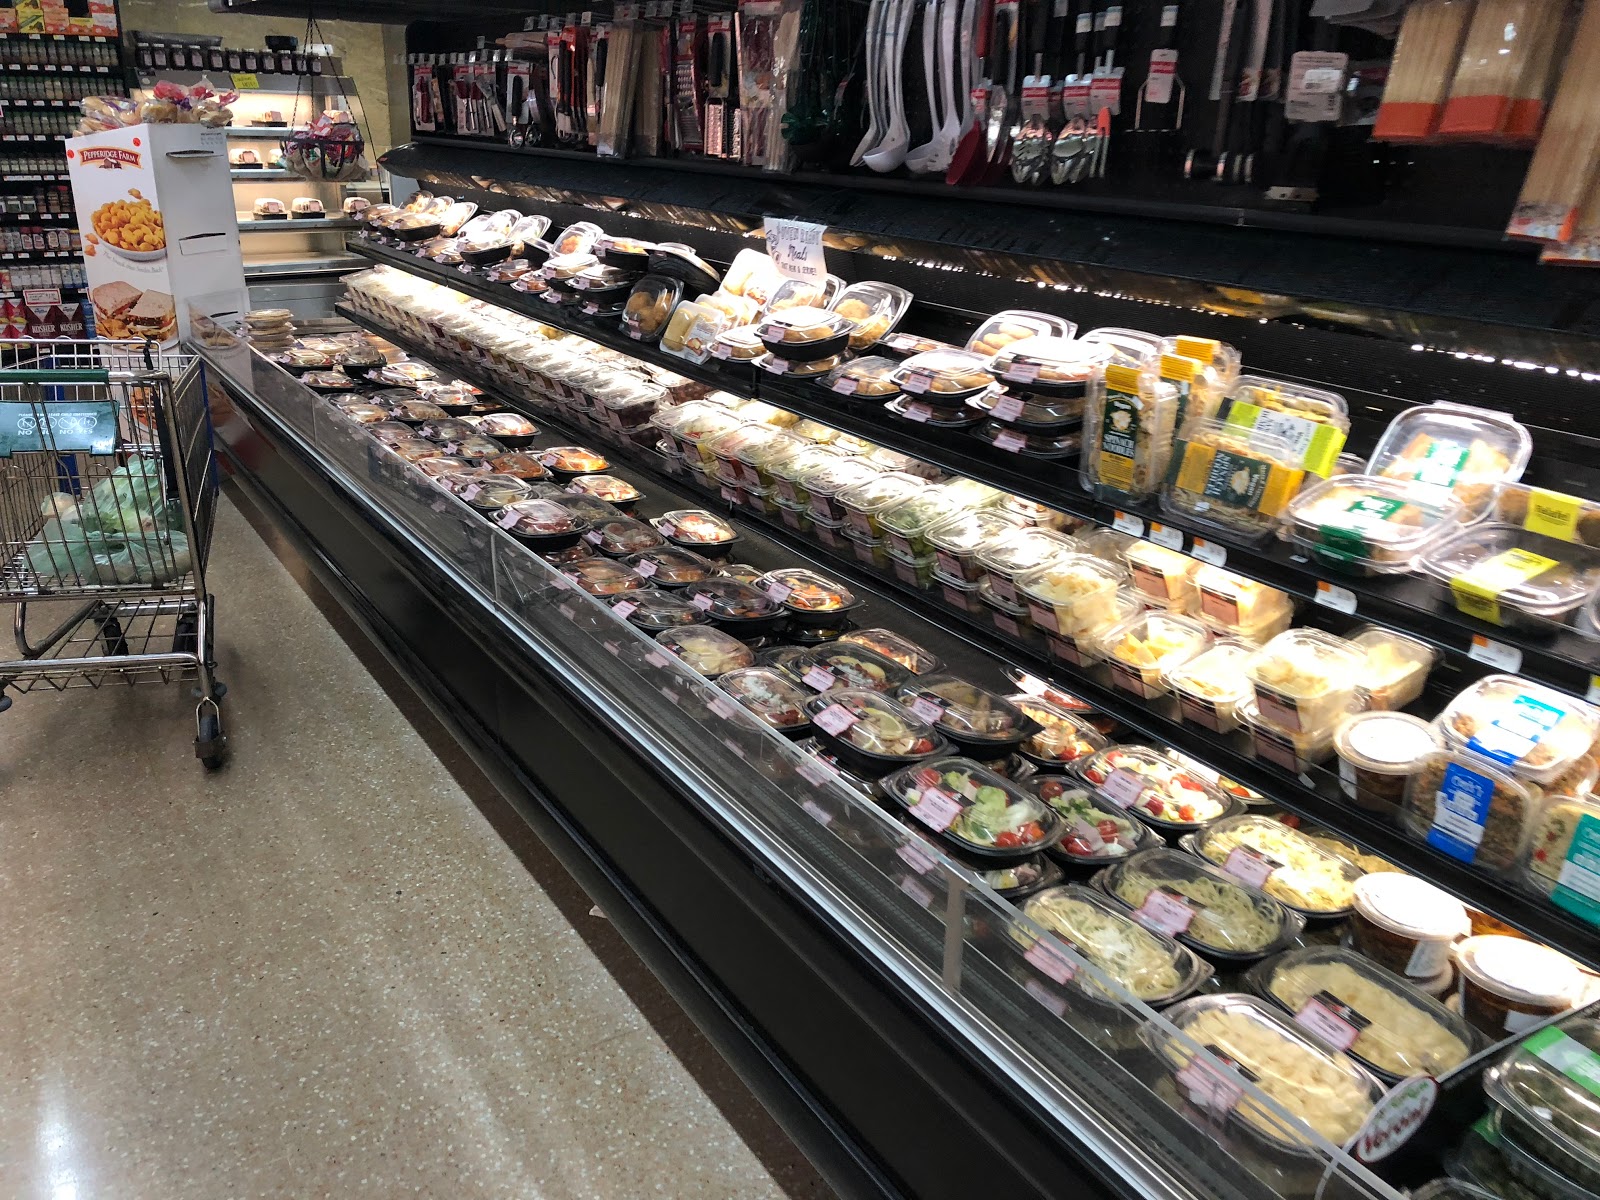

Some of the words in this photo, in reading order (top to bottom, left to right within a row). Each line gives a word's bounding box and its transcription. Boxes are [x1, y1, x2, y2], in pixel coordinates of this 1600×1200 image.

[83, 150, 117, 160] PEPPERIDGE
[118, 150, 136, 162] FARM
[787, 243, 808, 261] Meals
[32, 324, 56, 333] KOSHER
[60, 322, 83, 332] KOSHER
[1247, 474, 1260, 496] Vegan
